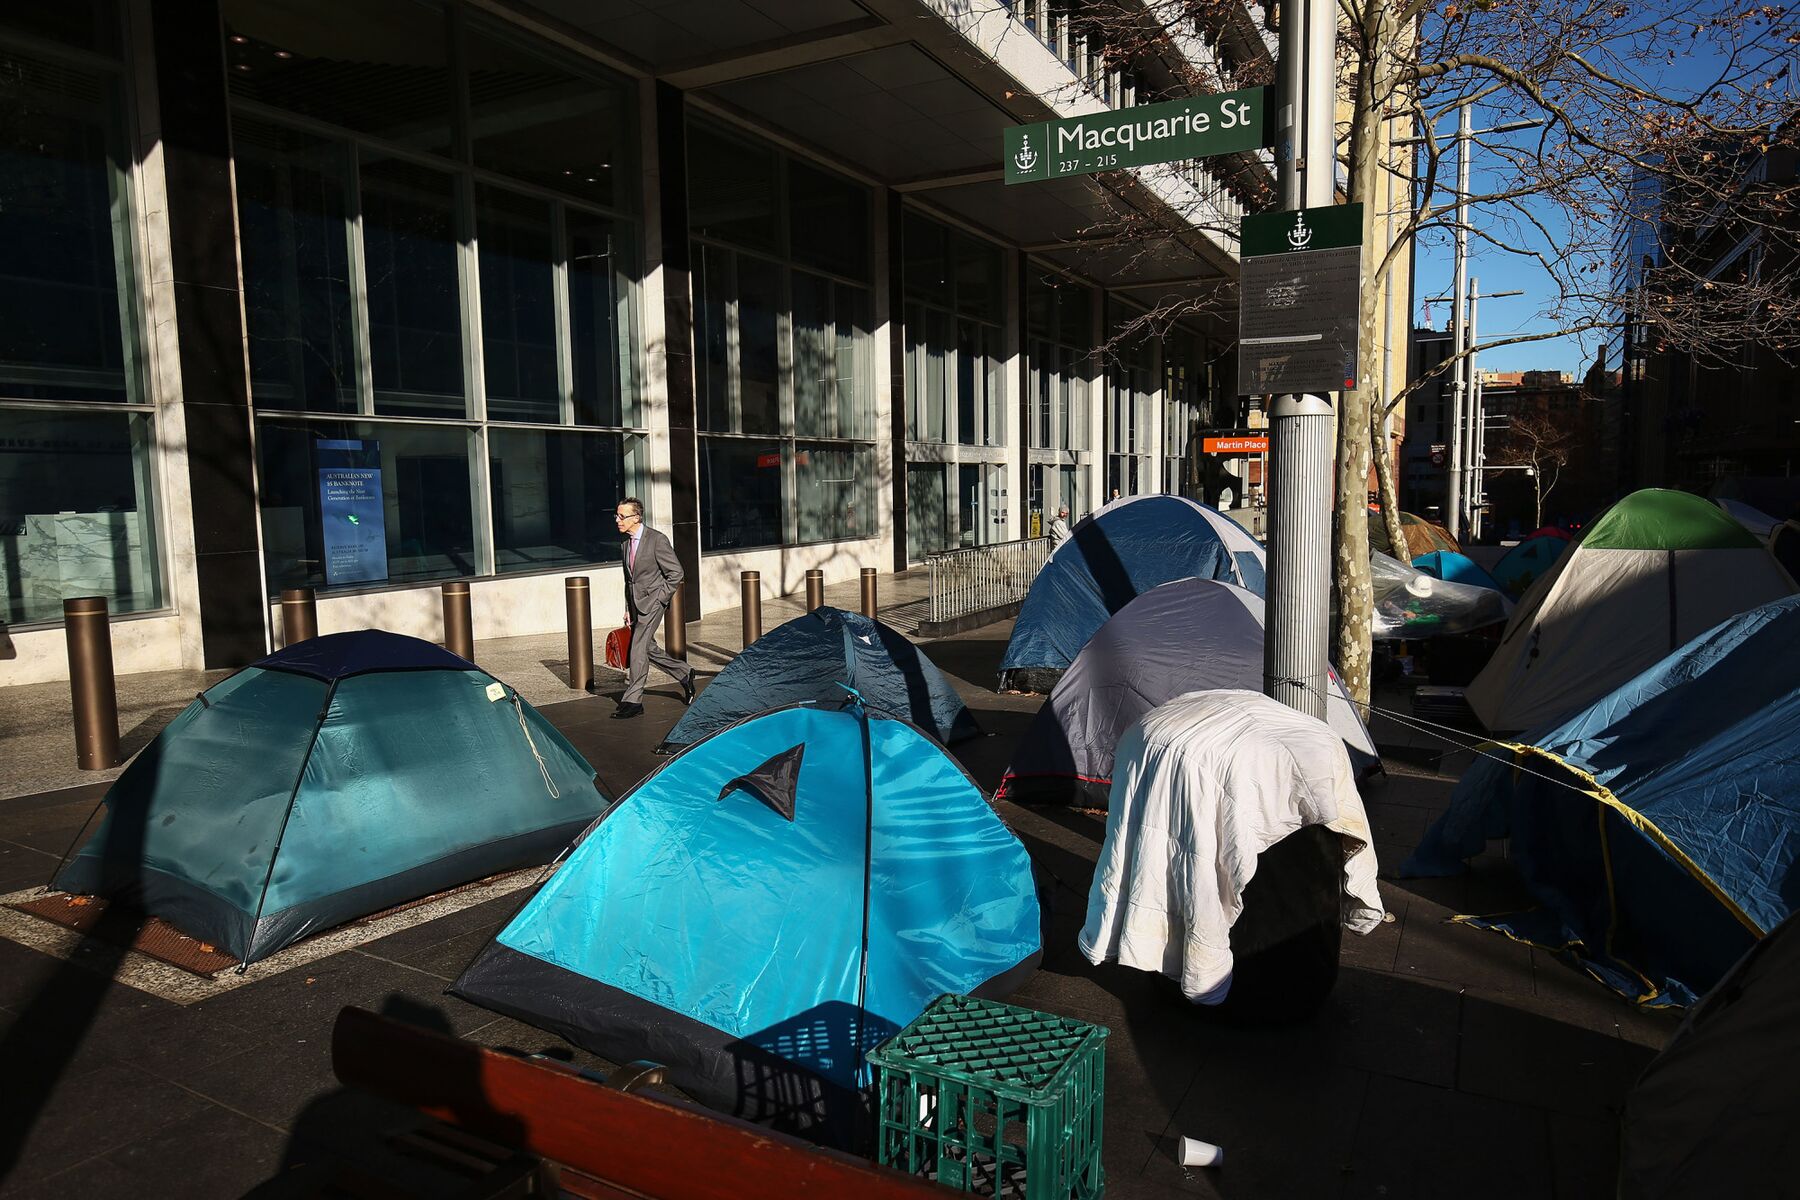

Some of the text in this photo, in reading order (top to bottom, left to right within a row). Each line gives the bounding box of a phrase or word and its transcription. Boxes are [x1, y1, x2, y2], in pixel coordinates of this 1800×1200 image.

[1057, 98, 1251, 154] Macquarie St
[1059, 159, 1079, 173] 237
[1096, 154, 1118, 168] 215
[1216, 440, 1267, 449] Martin Place
